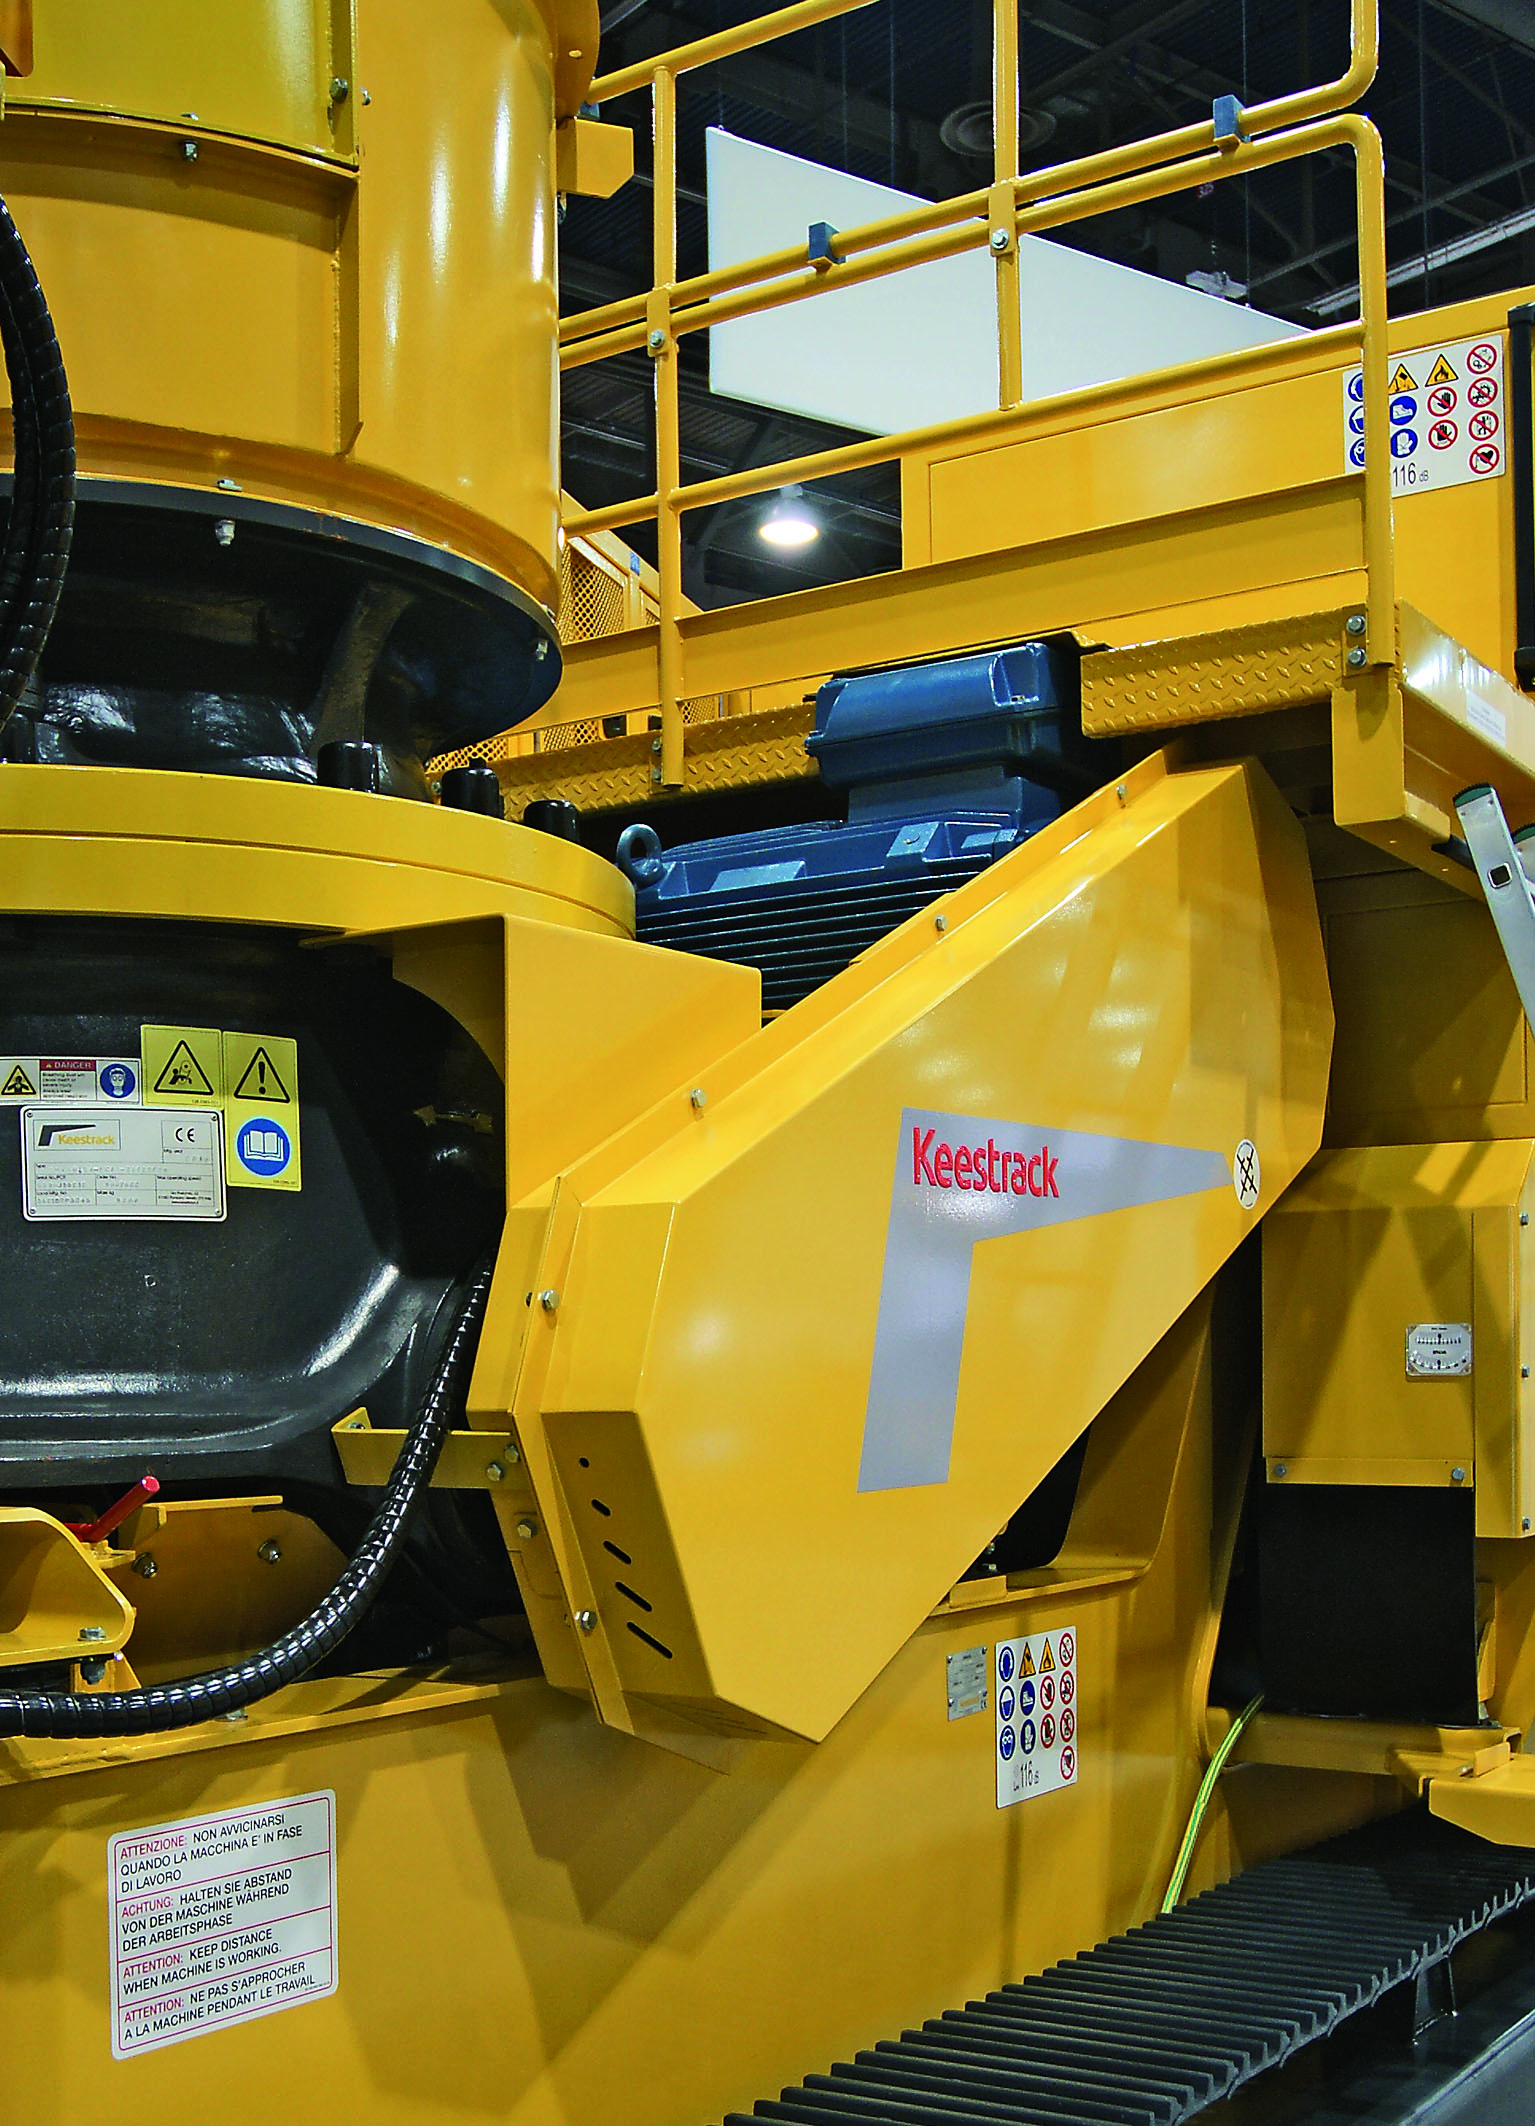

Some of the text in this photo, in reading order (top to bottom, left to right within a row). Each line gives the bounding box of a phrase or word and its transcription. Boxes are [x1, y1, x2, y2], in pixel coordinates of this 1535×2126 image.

[1392, 462, 1416, 487] 116
[54, 1061, 92, 1069] DANGER
[58, 1134, 115, 1145] Keestrack
[913, 1126, 1059, 1198] Keestrack
[1020, 1760, 1033, 1788] 116
[120, 1813, 285, 1860] ATTENZIONE: NON AVVICINARSI
[120, 1855, 171, 1876] QUANDO
[173, 1851, 188, 1864] LA
[190, 1838, 249, 1860] MACCHINA
[263, 1831, 274, 1844] IN
[277, 1825, 303, 1840] FASE
[121, 1869, 181, 1893] DI LAVORO
[121, 1868, 292, 1918] ACHTUNG: HALTEN SIE ABSTAND
[122, 1918, 147, 1935] VON
[149, 1912, 173, 1929] DER
[176, 1896, 234, 1922] MASCHINE
[123, 1912, 233, 1952] DER ARBEITSPHASE
[123, 1928, 273, 1979] ATTENTION: KEEP DISTANCE
[123, 1942, 282, 1995] WHEN MACHINE IS WORKING.
[124, 1997, 185, 2023] ATTENTION:
[190, 1990, 205, 2005] NE
[208, 1983, 229, 1999] PAS
[231, 1961, 305, 1992] S'APPROCHER
[124, 2028, 133, 2041] A
[135, 2023, 150, 2037] LA
[153, 2006, 205, 2032] MACHINE
[207, 1990, 258, 2015] PENDANT
[260, 1986, 273, 2000] LE
[275, 1974, 316, 1995] TRAVAIL
